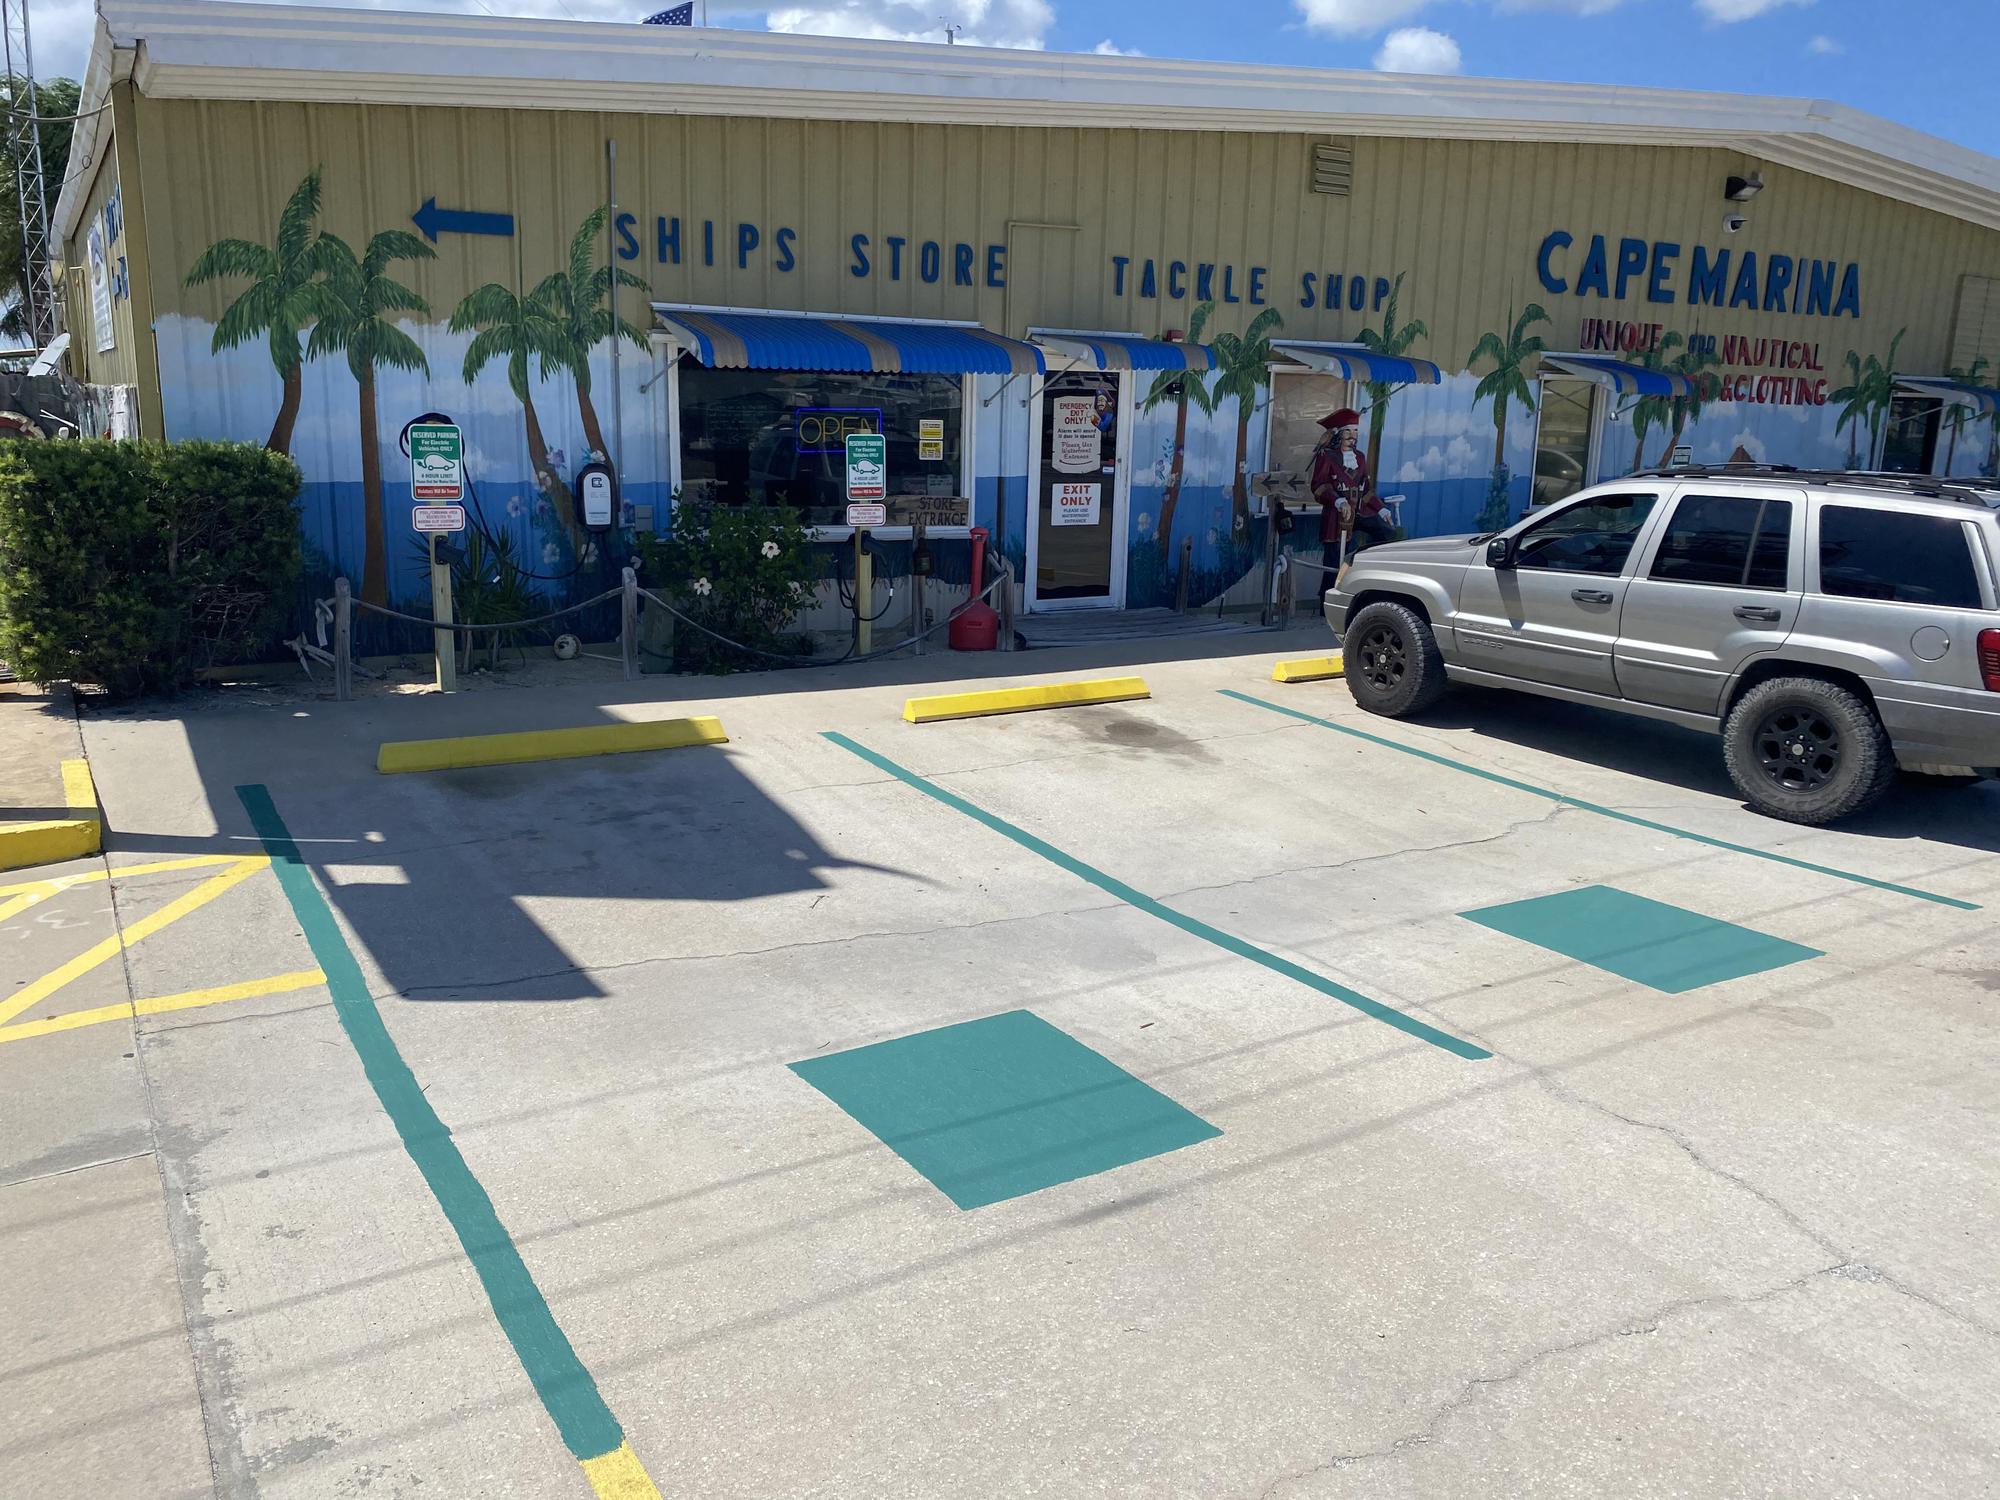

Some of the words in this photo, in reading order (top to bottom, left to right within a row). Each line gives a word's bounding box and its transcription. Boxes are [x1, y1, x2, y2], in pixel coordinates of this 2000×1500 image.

[616, 213, 796, 272] SHIPS
[851, 233, 1006, 288] STORE
[1113, 256, 1266, 305] TACKLE
[1300, 272, 1390, 312] SHOP
[1537, 231, 1681, 304] CAPE
[1688, 245, 1860, 318] MARINA
[1580, 318, 1663, 352] UNIQUE
[1721, 335, 1825, 371] NAUTICAL
[1060, 402, 1093, 410] EMERGENCY
[799, 416, 879, 444] OPEN
[1064, 417, 1087, 425] ONLY!
[1063, 485, 1091, 494] EXIT
[920, 497, 957, 511] STORE
[1060, 496, 1092, 506] ONLY
